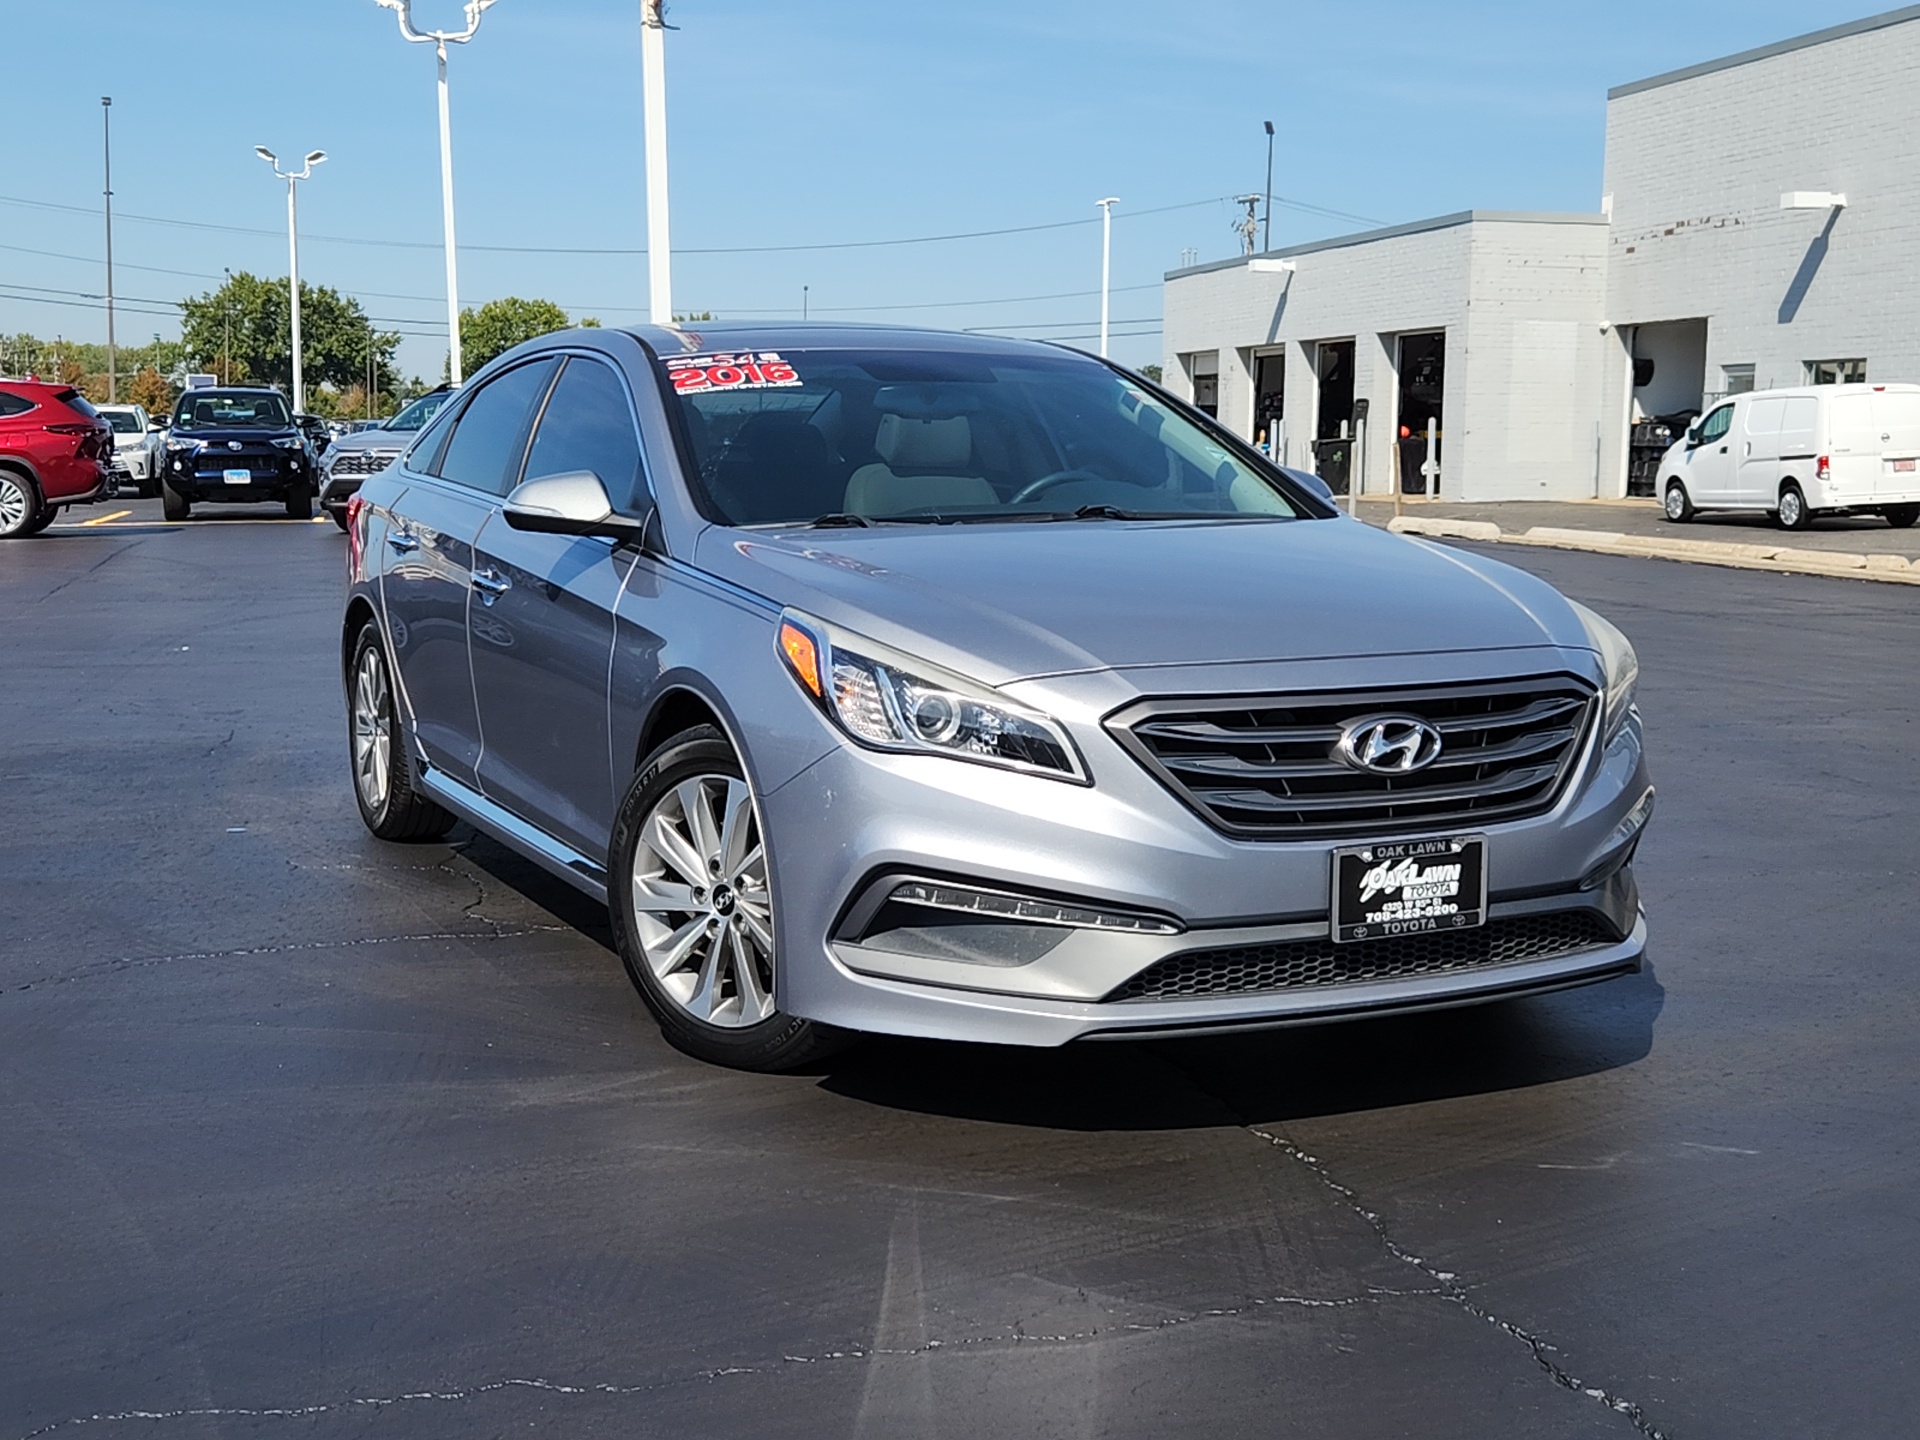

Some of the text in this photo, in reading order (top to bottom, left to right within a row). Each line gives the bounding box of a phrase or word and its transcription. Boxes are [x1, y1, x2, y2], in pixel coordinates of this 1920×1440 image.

[669, 363, 798, 390] 2016
[1377, 840, 1446, 857] OAK LAWN
[1410, 884, 1451, 896] TOYOTA
[1382, 918, 1437, 934] TOYOTA
